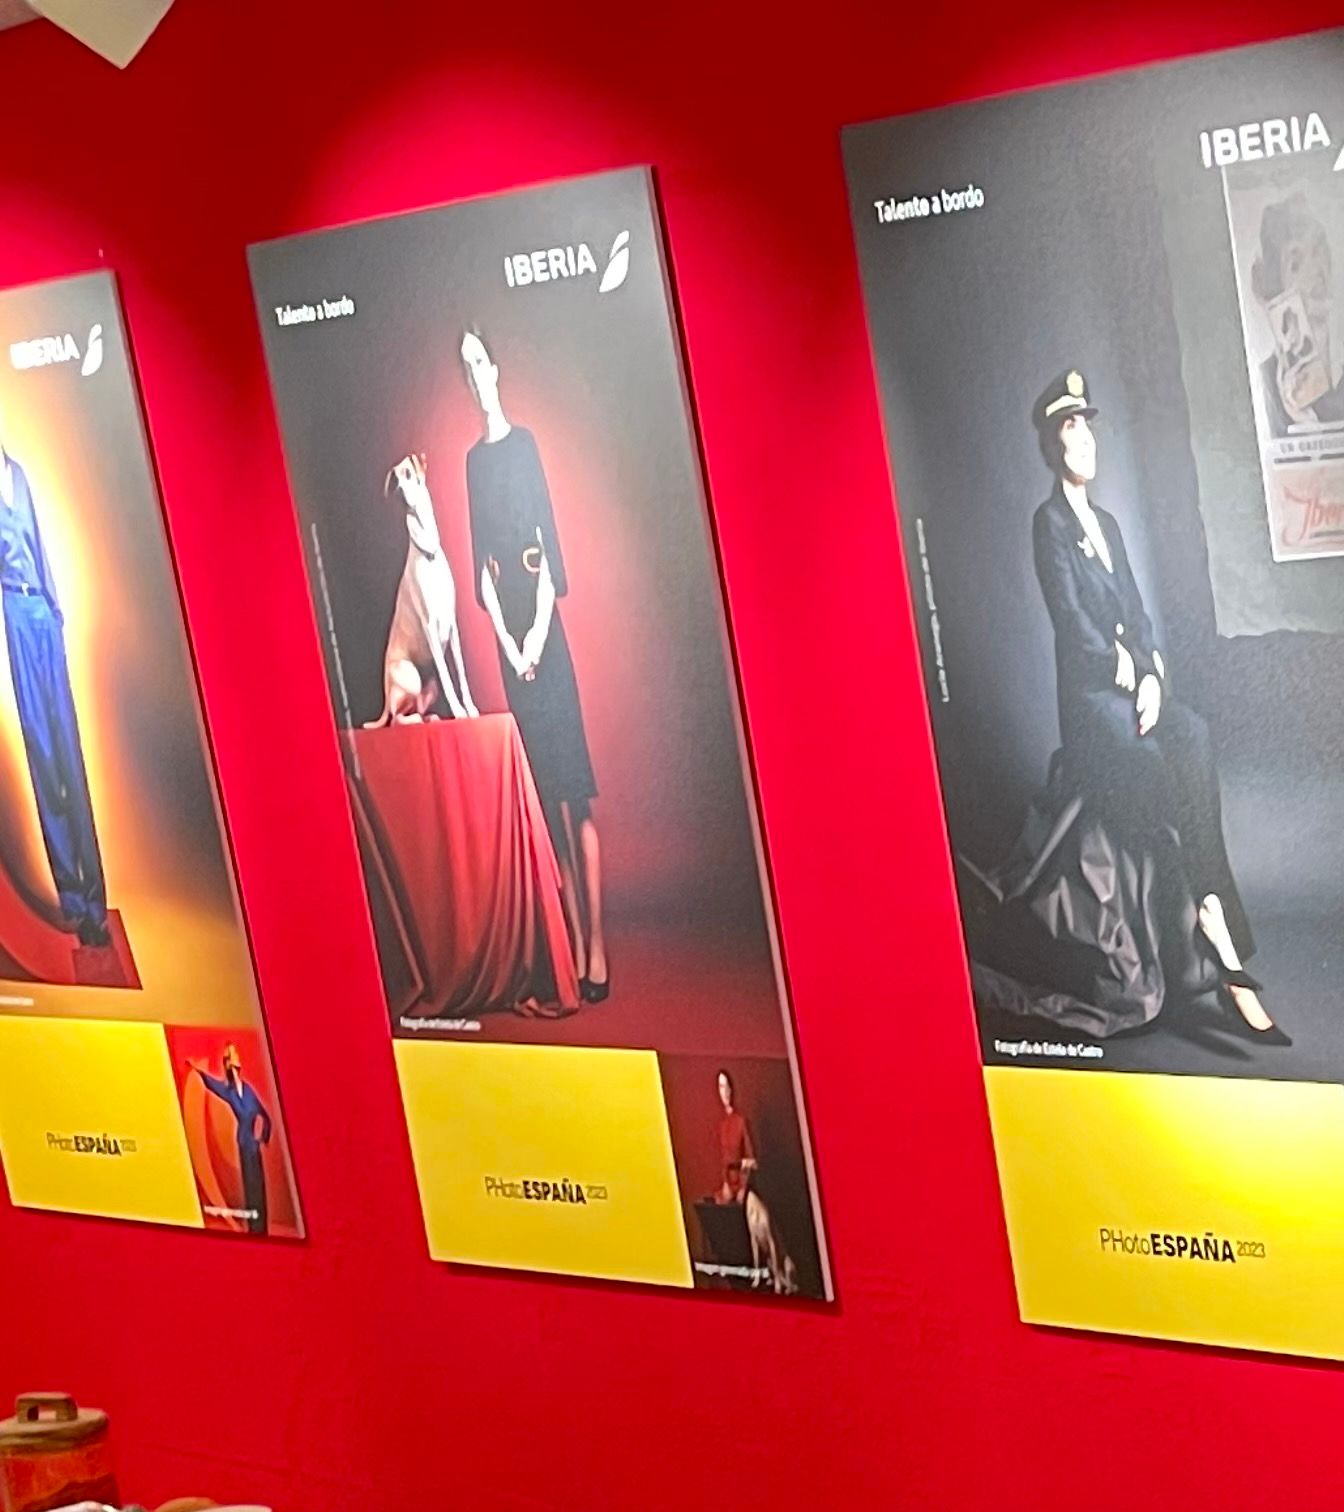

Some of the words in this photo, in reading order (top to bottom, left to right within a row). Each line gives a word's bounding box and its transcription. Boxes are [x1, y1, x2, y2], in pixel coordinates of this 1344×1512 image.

[1199, 112, 1332, 169] IBERIA
[873, 196, 931, 224] Talento
[941, 184, 985, 213] bordo
[503, 243, 598, 288] IBERIA
[1099, 1228, 1236, 1264] PHotoESPAÑA
[1236, 1240, 1267, 1259] 2023
